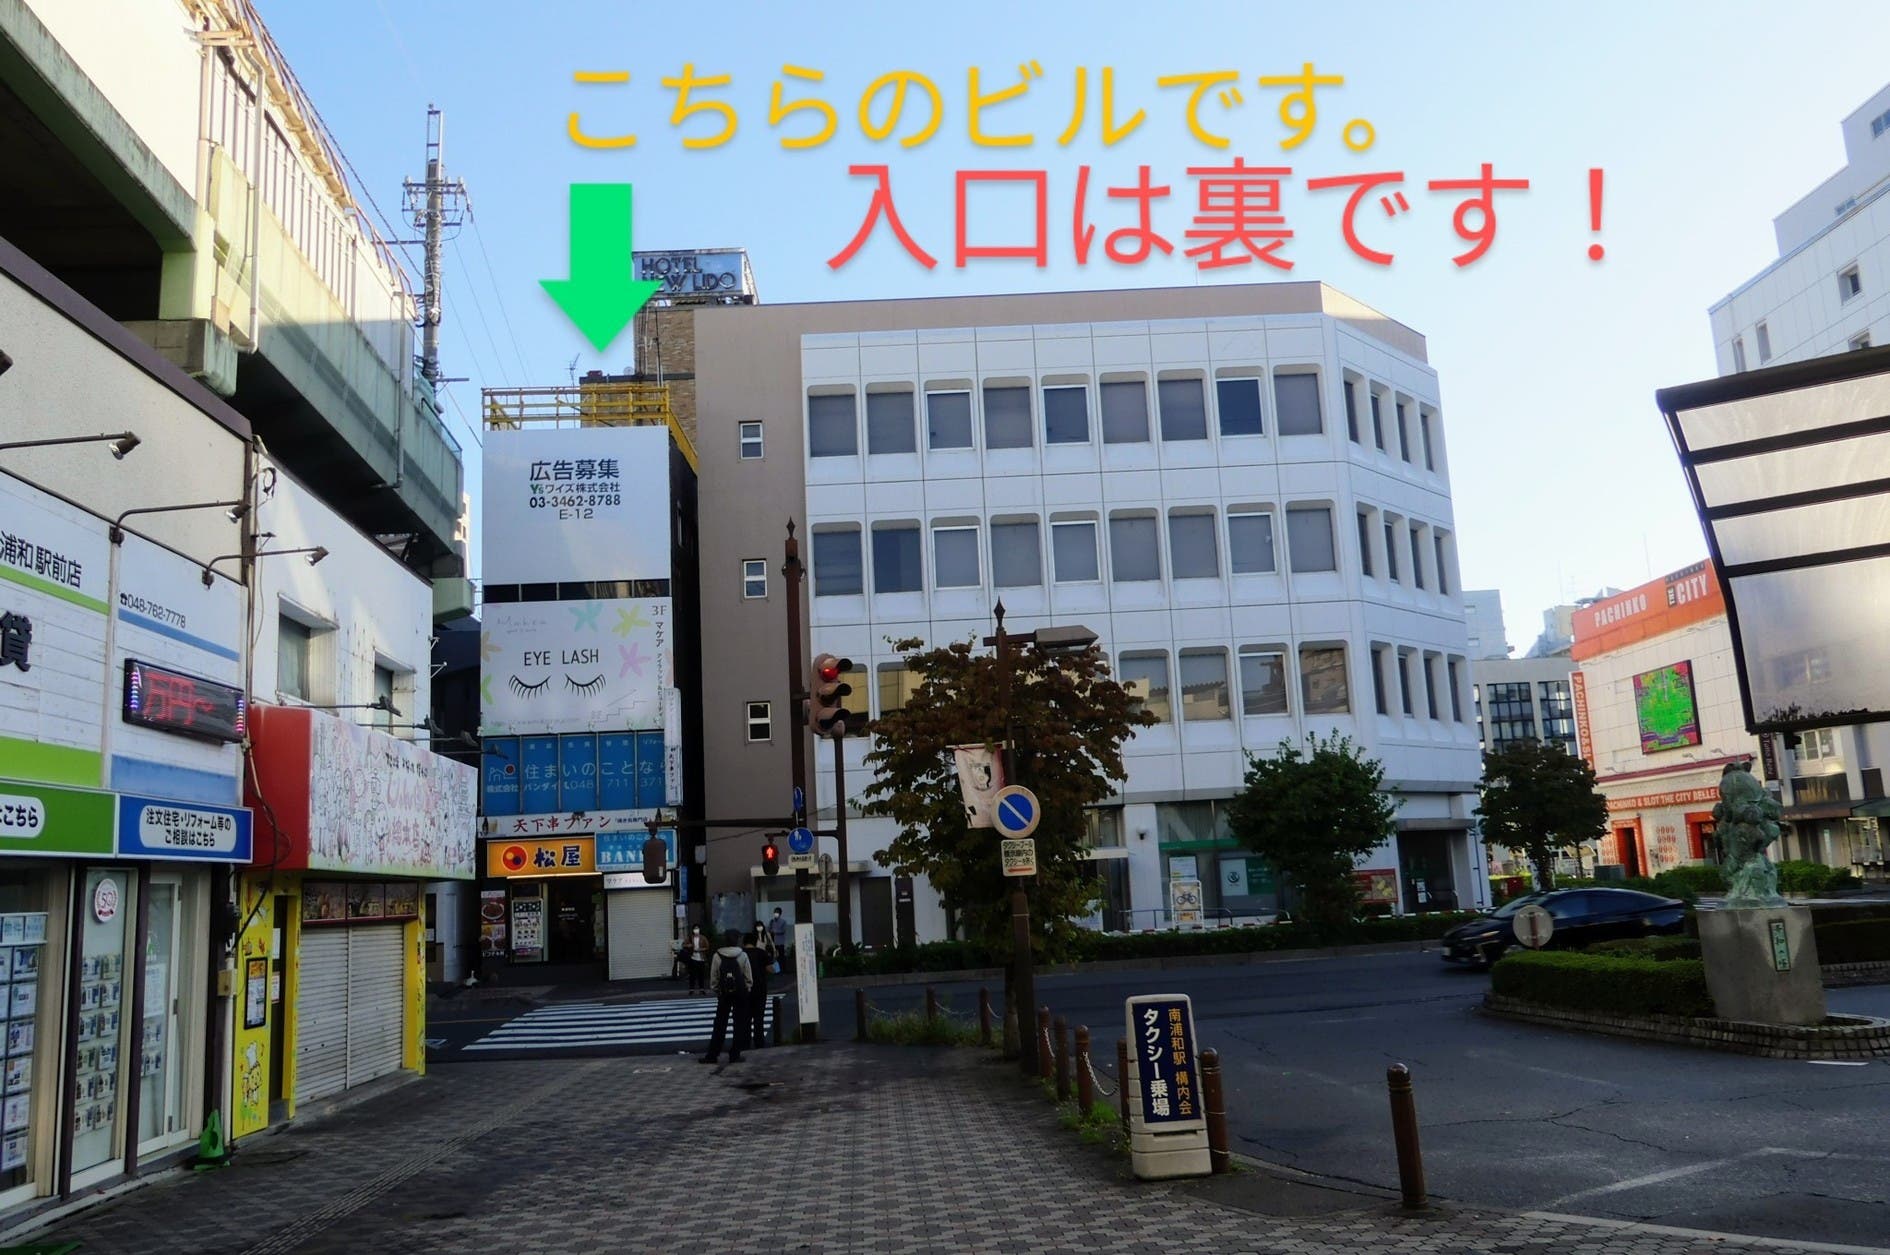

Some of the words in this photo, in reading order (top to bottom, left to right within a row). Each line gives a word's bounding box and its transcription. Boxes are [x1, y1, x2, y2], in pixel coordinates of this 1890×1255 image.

[640, 255, 703, 275] HOTEL
[692, 271, 736, 291] LIDO
[529, 458, 619, 481] 広告募集
[529, 493, 621, 508] 03-3462-8788
[559, 508, 594, 520] E-12
[0, 530, 82, 589] 浦和駅前店
[1667, 587, 1676, 607] THE
[1676, 573, 1707, 605] CITY
[127, 593, 187, 628] 048-762-7778
[1593, 592, 1647, 629] PACHINKO
[524, 651, 551, 666] EYE
[562, 649, 599, 665] LASH
[487, 784, 519, 793] 株式会社
[570, 780, 594, 790] 048
[1661, 793, 1675, 805] THE
[1675, 791, 1692, 802] CITY
[146, 807, 232, 831] 注文住宅・リフォーム等の
[164, 828, 216, 847] ご相談はこちら
[533, 845, 581, 869] 松屋
[600, 848, 670, 864] BANI
[1168, 1007, 1187, 1065] 南浦和駅
[1143, 1008, 1170, 1117] タクシー乗場
[1175, 1071, 1193, 1115] 構内会
